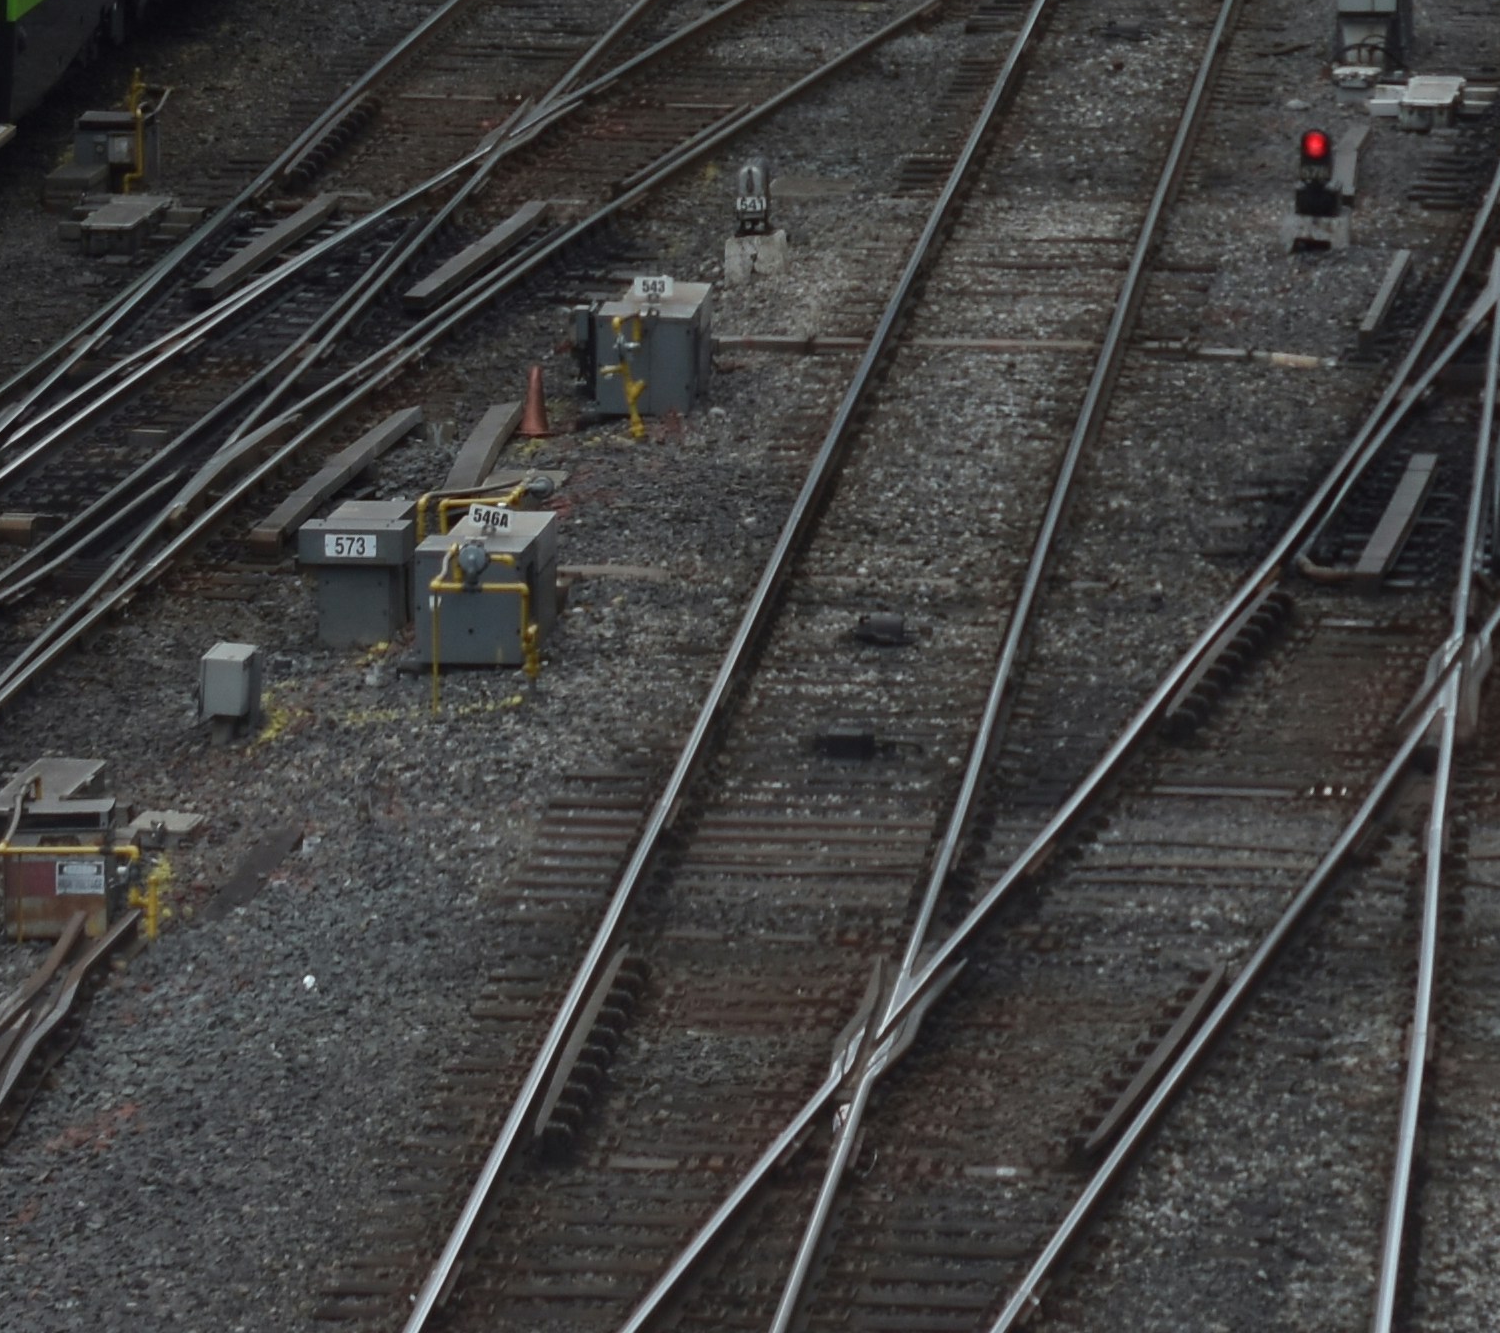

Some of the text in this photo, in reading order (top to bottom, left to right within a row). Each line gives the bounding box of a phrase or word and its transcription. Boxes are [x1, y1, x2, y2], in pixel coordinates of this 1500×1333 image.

[642, 280, 665, 294] 543
[473, 508, 510, 529] 546A
[334, 536, 366, 555] 573
